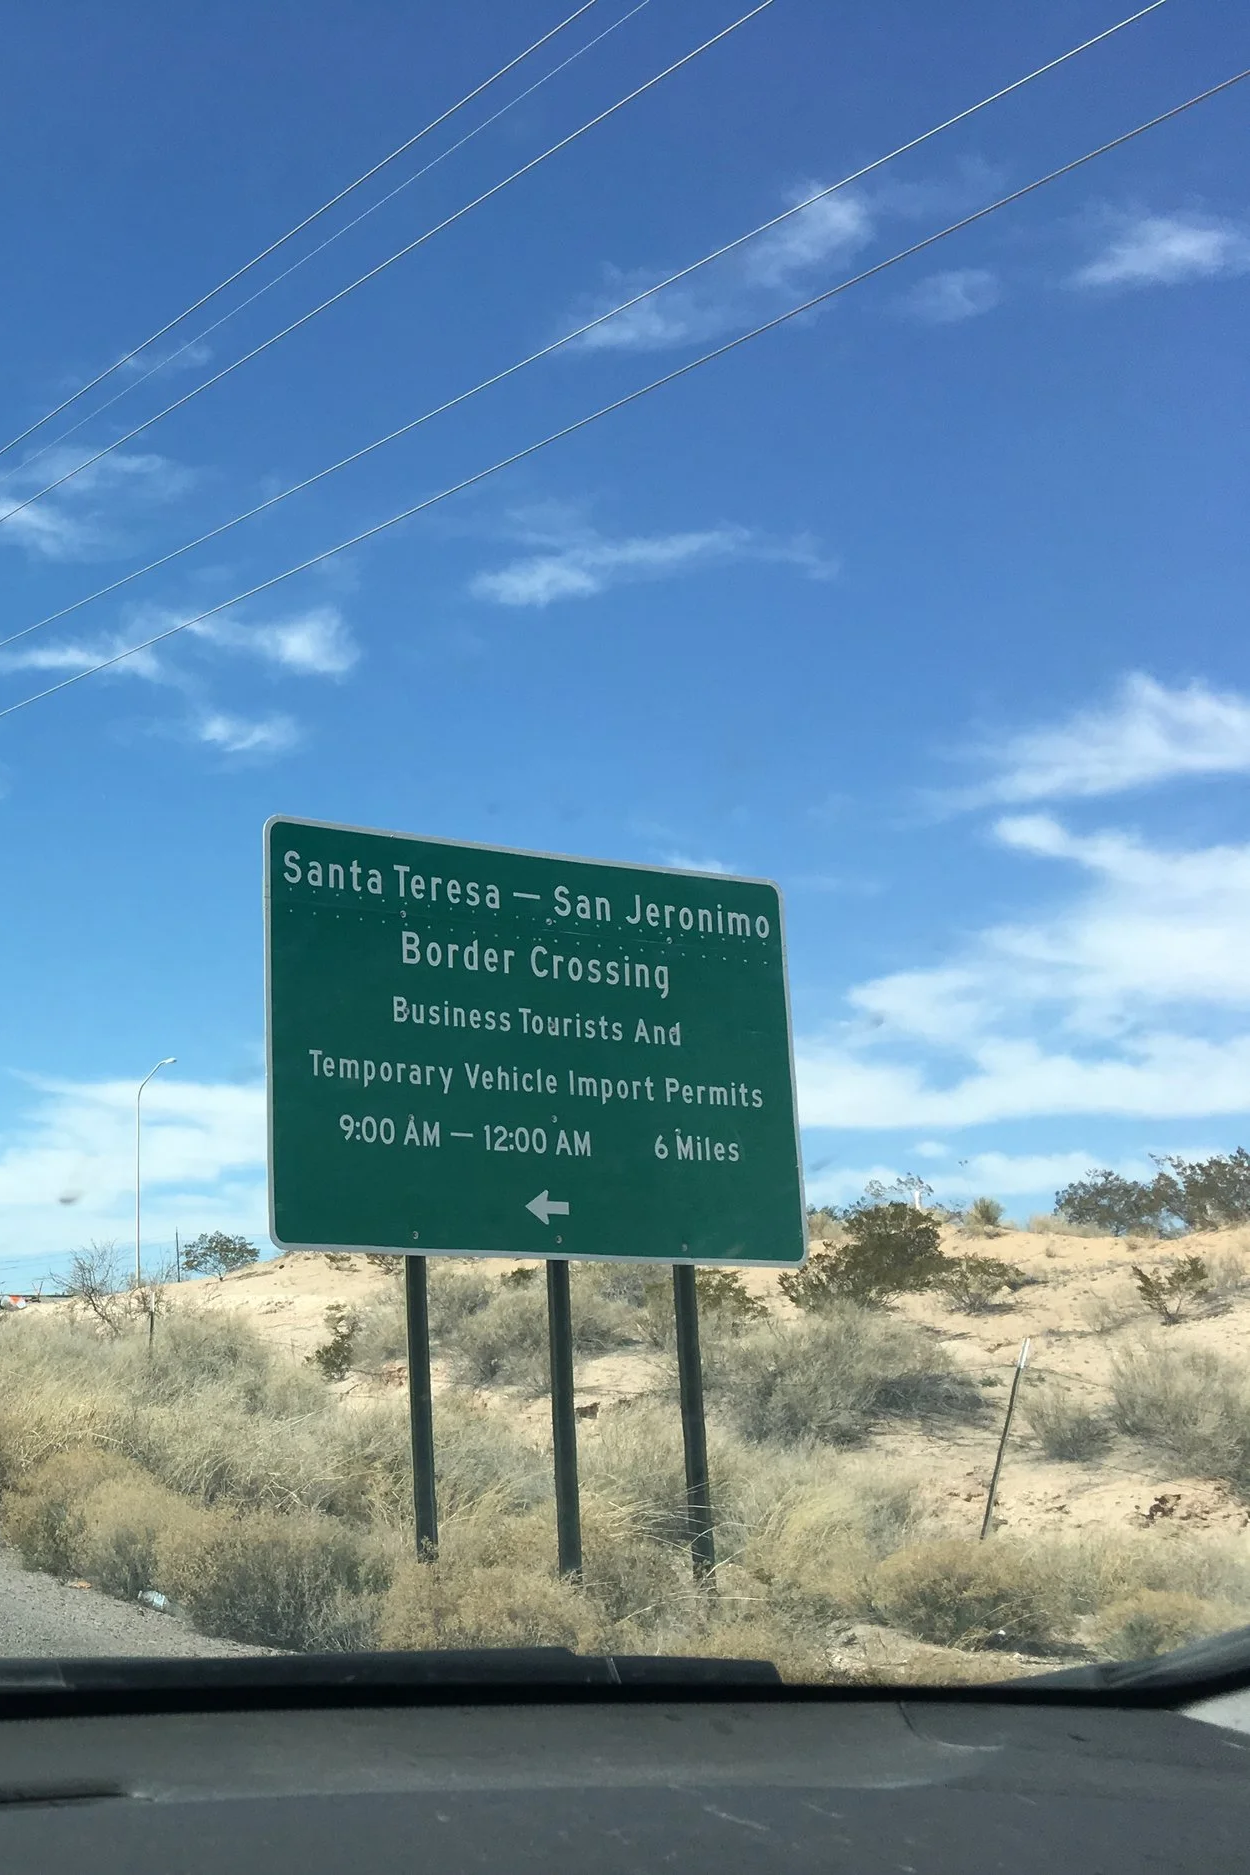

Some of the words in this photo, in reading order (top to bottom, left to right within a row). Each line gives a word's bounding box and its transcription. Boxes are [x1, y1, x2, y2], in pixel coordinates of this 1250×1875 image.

[283, 849, 383, 896] Santa
[393, 864, 501, 909] Teresa
[554, 886, 611, 921] San
[626, 895, 770, 940] Jeronimo
[401, 931, 515, 975] Border
[530, 945, 670, 999] Crossing
[393, 996, 511, 1032] Business
[519, 1007, 623, 1042] Tourists
[634, 1017, 681, 1047] And
[309, 1049, 453, 1095] Temporary
[465, 1062, 558, 1095] Vehicle
[569, 1070, 655, 1105] Import
[666, 1078, 763, 1109] Permits
[339, 1114, 395, 1145] 9:00
[403, 1119, 441, 1148] AM
[483, 1124, 547, 1154] 12:00
[555, 1129, 591, 1157] AM
[654, 1134, 668, 1160] 6
[676, 1134, 740, 1162] Miles
